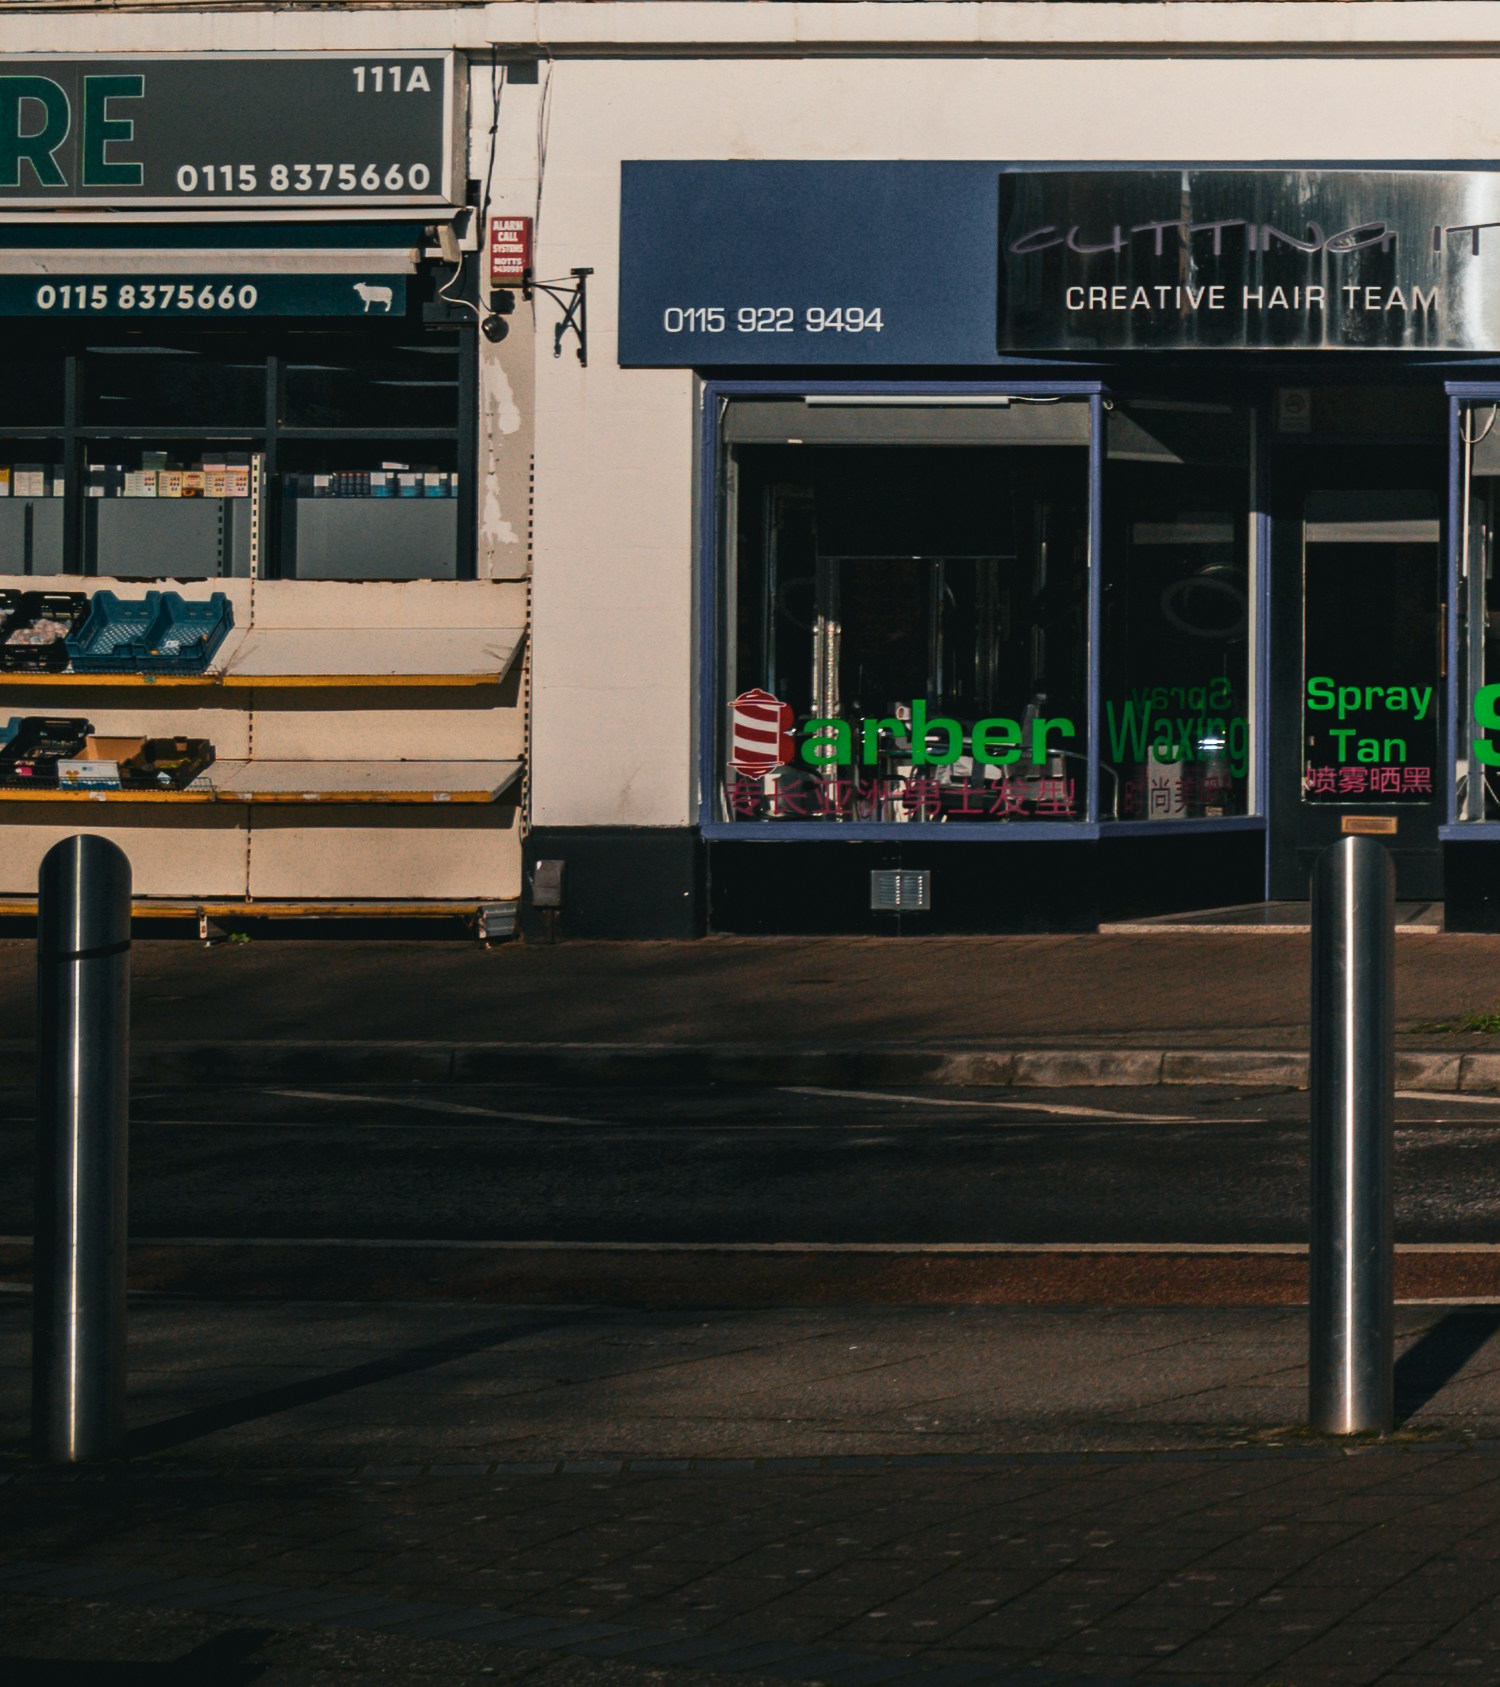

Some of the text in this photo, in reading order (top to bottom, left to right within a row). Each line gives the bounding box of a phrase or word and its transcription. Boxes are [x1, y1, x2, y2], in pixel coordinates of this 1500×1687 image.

[353, 66, 430, 92] 111A
[177, 162, 430, 192] 0115 8375660
[493, 221, 523, 230] ALARM
[498, 232, 518, 241] CALL
[493, 244, 523, 252] SYSTEMS
[37, 285, 257, 310] 0115 8375660
[1066, 285, 1439, 310] CREATIVE HAIR TEAM
[664, 307, 884, 333] 0115 922 9494
[1307, 676, 1432, 720] Spray
[1106, 699, 1250, 780] Waxing
[1329, 729, 1407, 762] Tan
[1305, 765, 1432, 793] 喷雾晒黑
